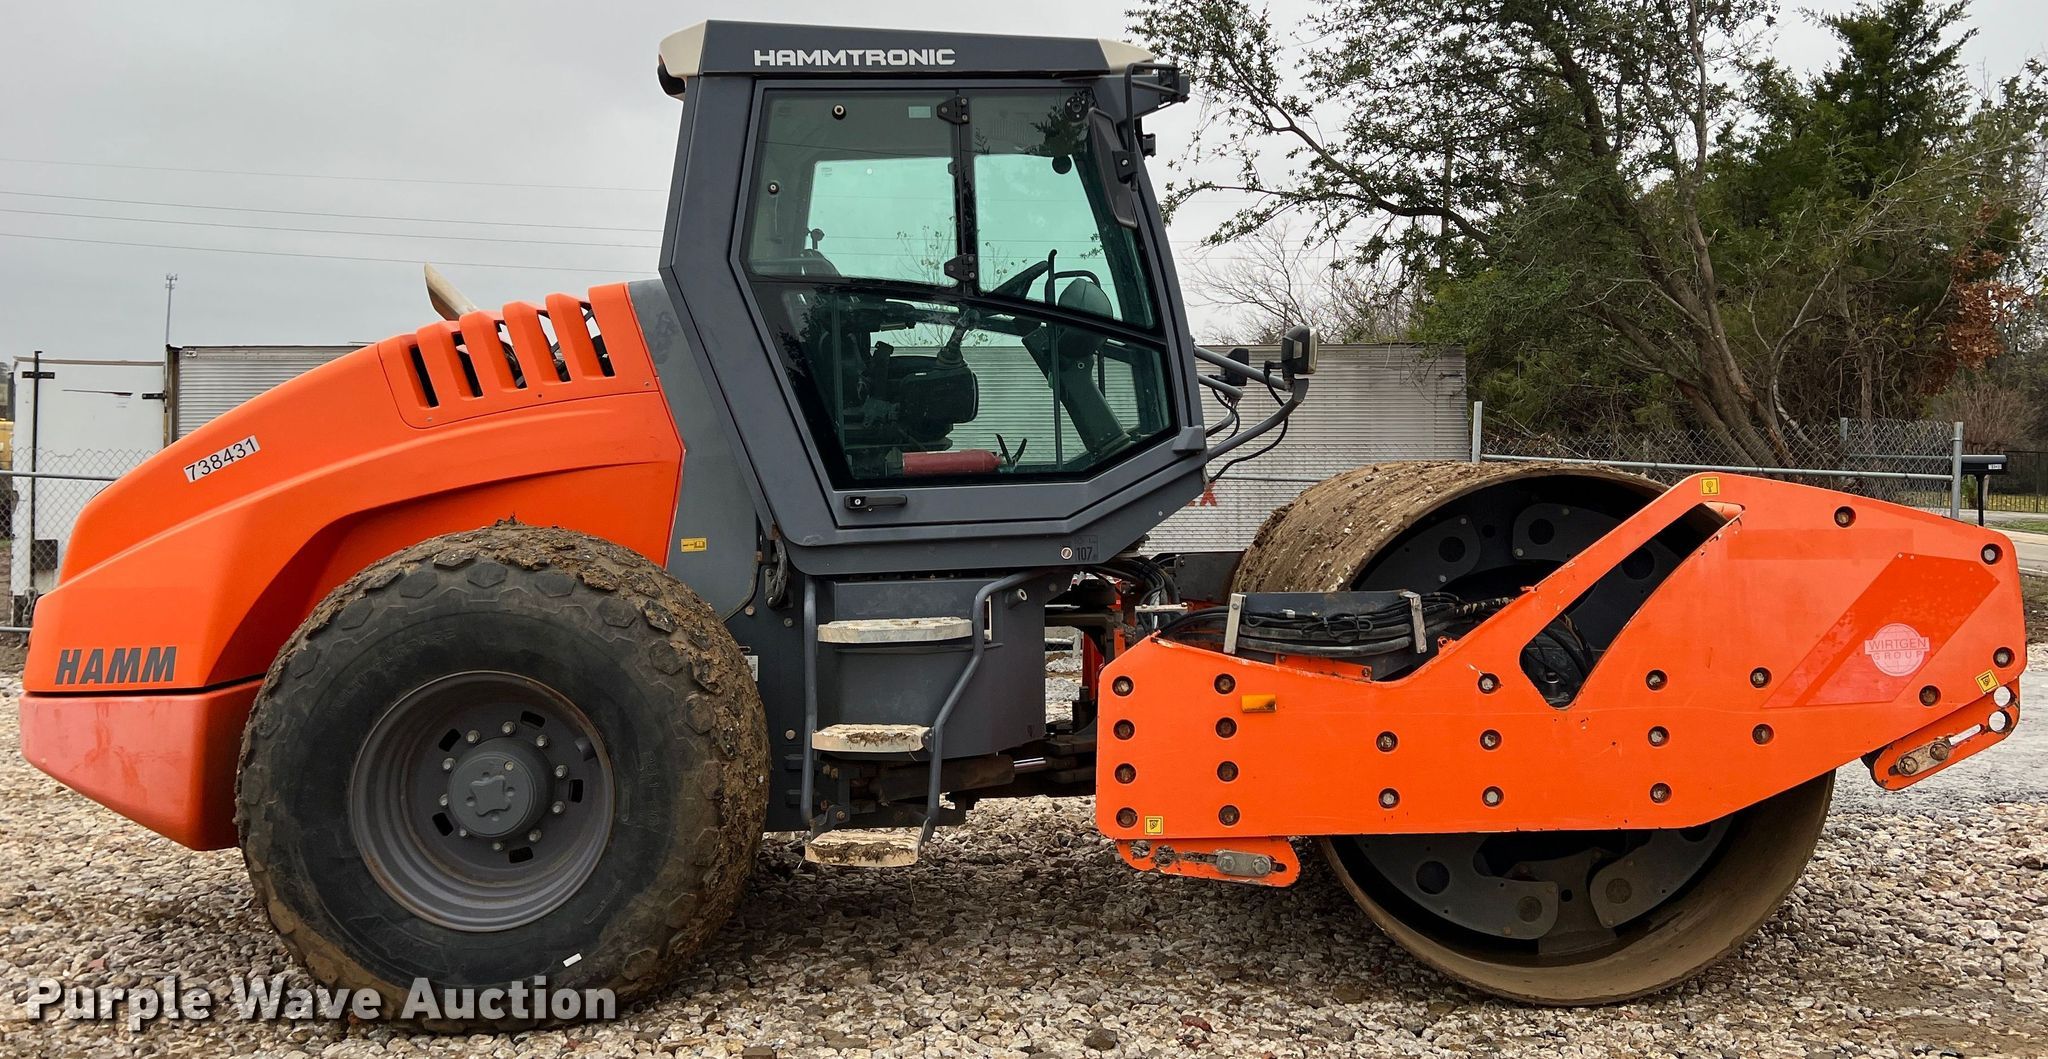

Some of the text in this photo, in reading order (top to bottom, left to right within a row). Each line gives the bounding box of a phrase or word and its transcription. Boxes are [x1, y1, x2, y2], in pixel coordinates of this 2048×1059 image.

[754, 48, 956, 66] HAMMTRONIC
[185, 437, 257, 481] 738431
[1076, 546, 1093, 561] 107
[1868, 637, 1927, 651] WIRTGEN
[1872, 650, 1923, 661] GROUP
[55, 645, 177, 686] HAMM
